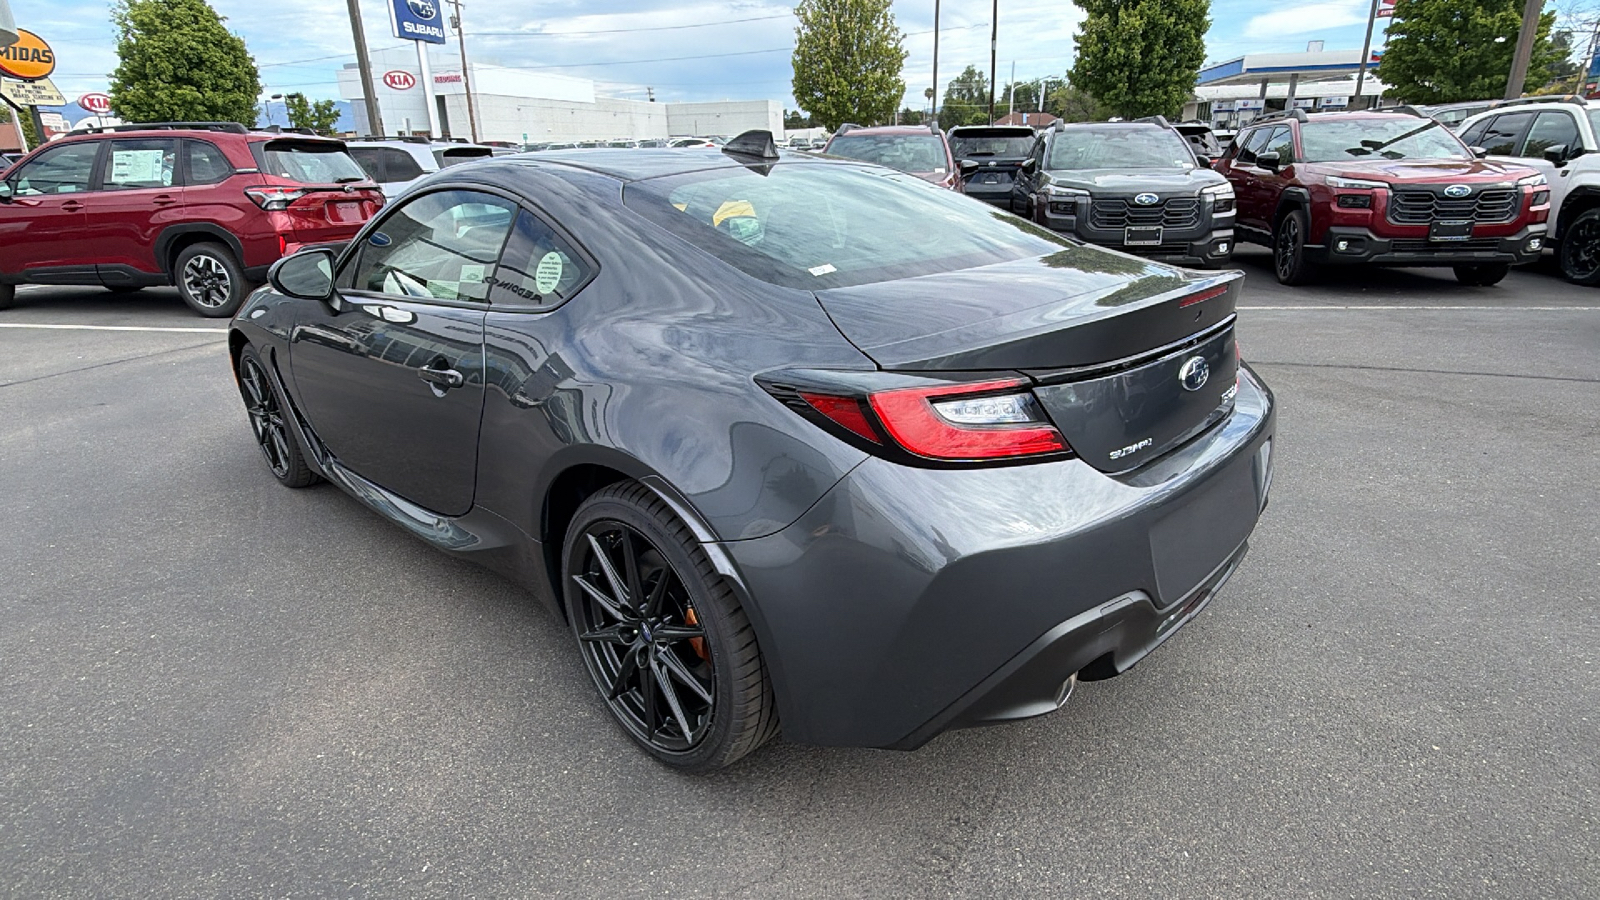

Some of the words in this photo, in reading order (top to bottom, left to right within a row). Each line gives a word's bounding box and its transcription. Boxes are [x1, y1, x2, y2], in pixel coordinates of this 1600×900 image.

[403, 21, 443, 37] SUBARU
[0, 45, 52, 63] MIDAS
[388, 75, 411, 86] KIA
[1109, 437, 1152, 460] SUBARU
